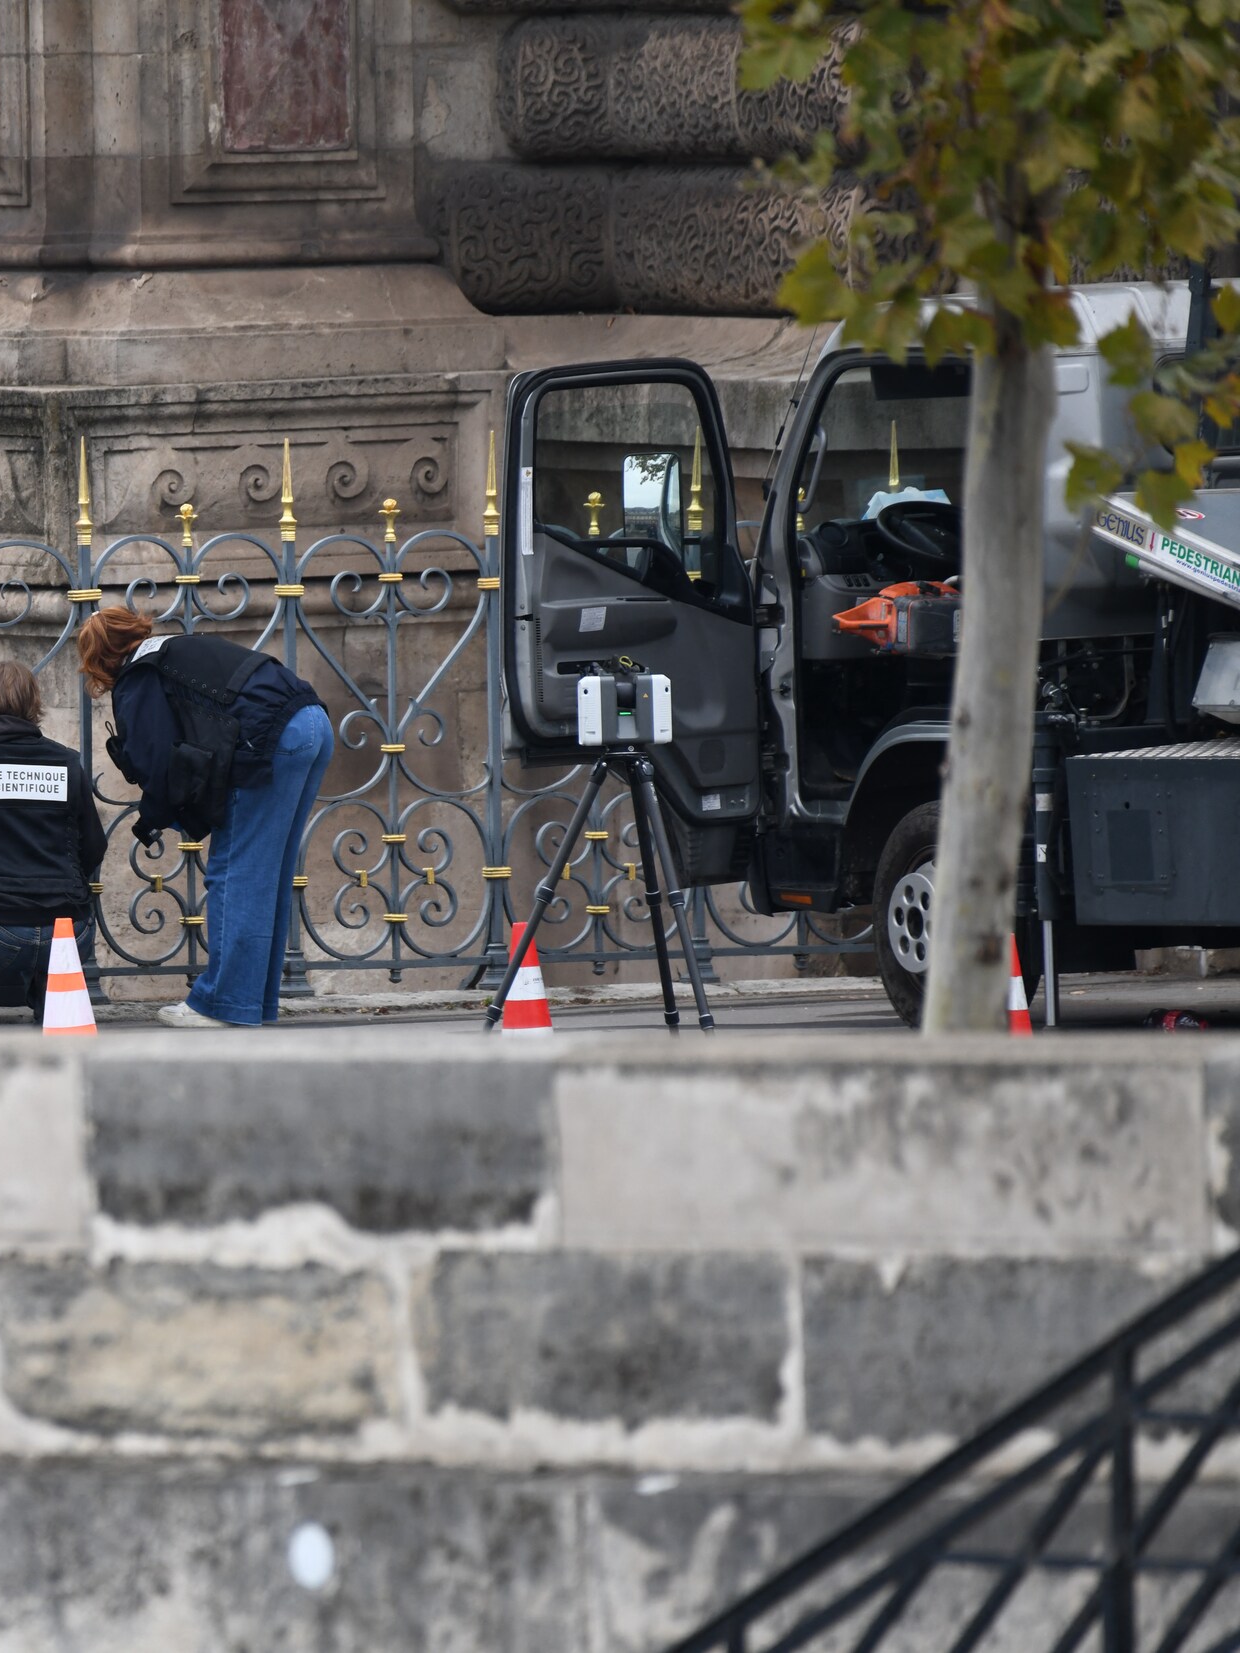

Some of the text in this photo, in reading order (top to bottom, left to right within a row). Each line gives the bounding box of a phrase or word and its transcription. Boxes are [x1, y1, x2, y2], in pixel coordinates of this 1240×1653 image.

[1096, 510, 1145, 546] GENIUS
[1161, 536, 1240, 587] PEDESTRIAN
[7, 771, 66, 782] TECHNIQUE
